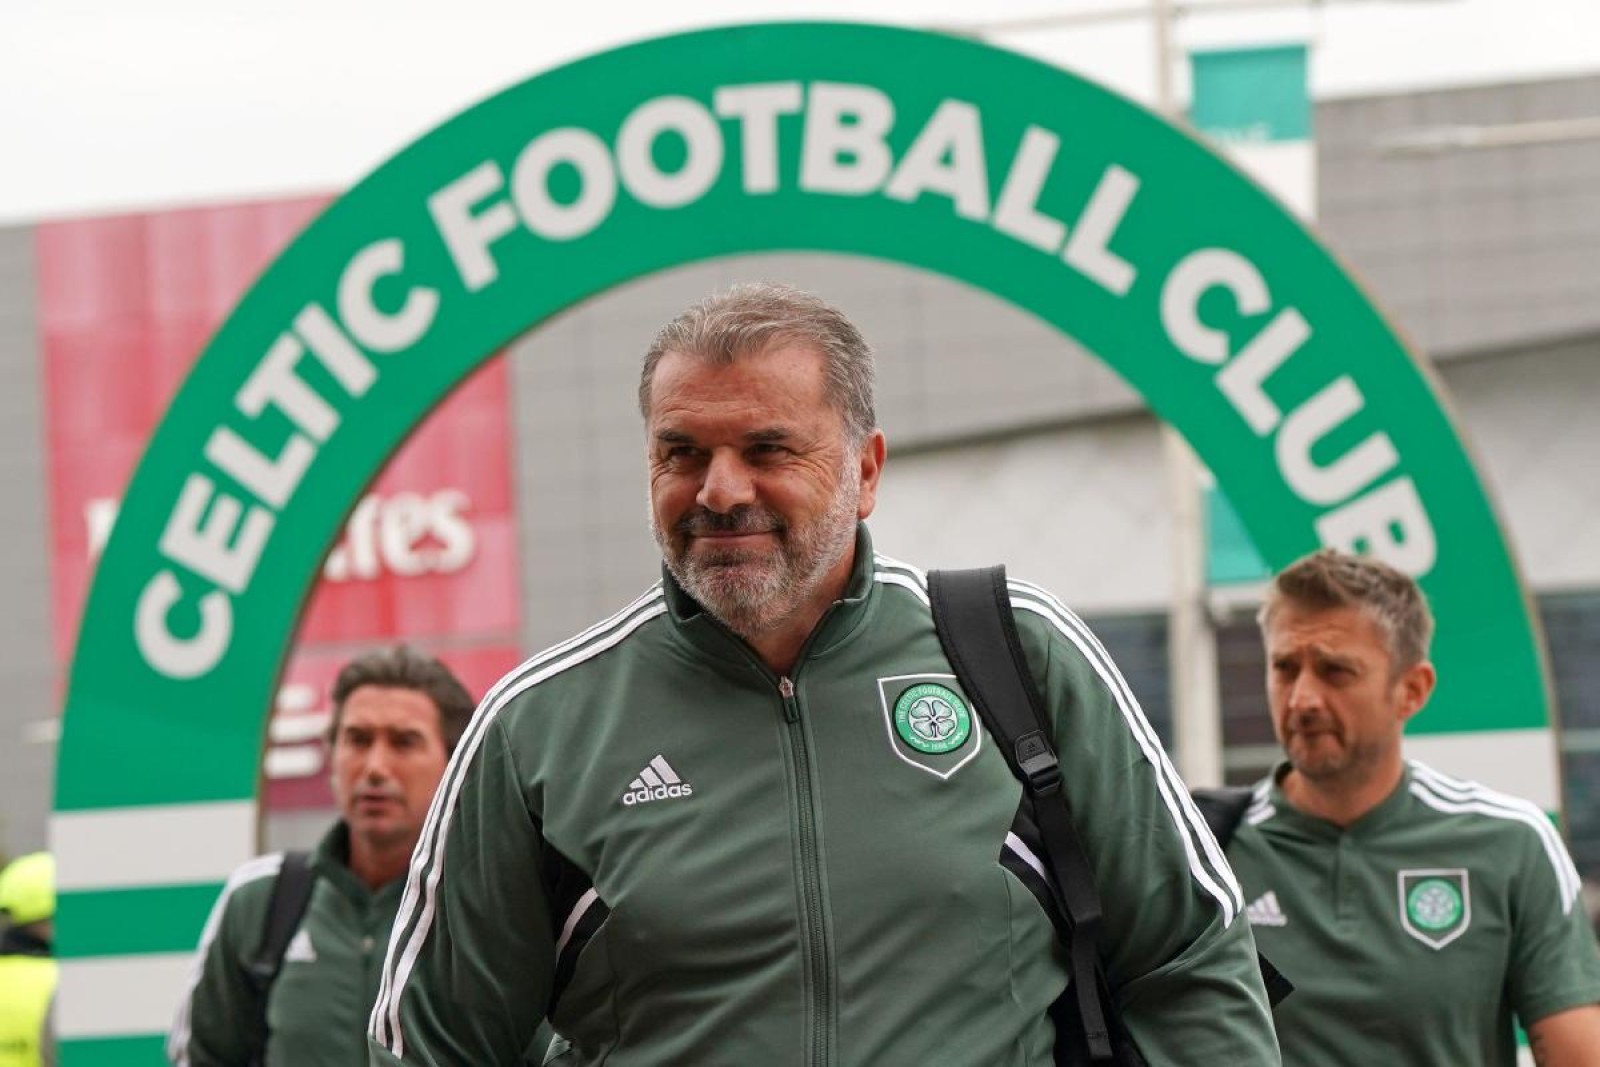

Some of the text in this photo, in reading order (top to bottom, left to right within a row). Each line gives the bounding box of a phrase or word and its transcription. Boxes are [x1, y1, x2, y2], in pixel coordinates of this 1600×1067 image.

[135, 82, 1437, 679] CELTIC FOOTBALL CLUB
[622, 782, 693, 805] adidas
